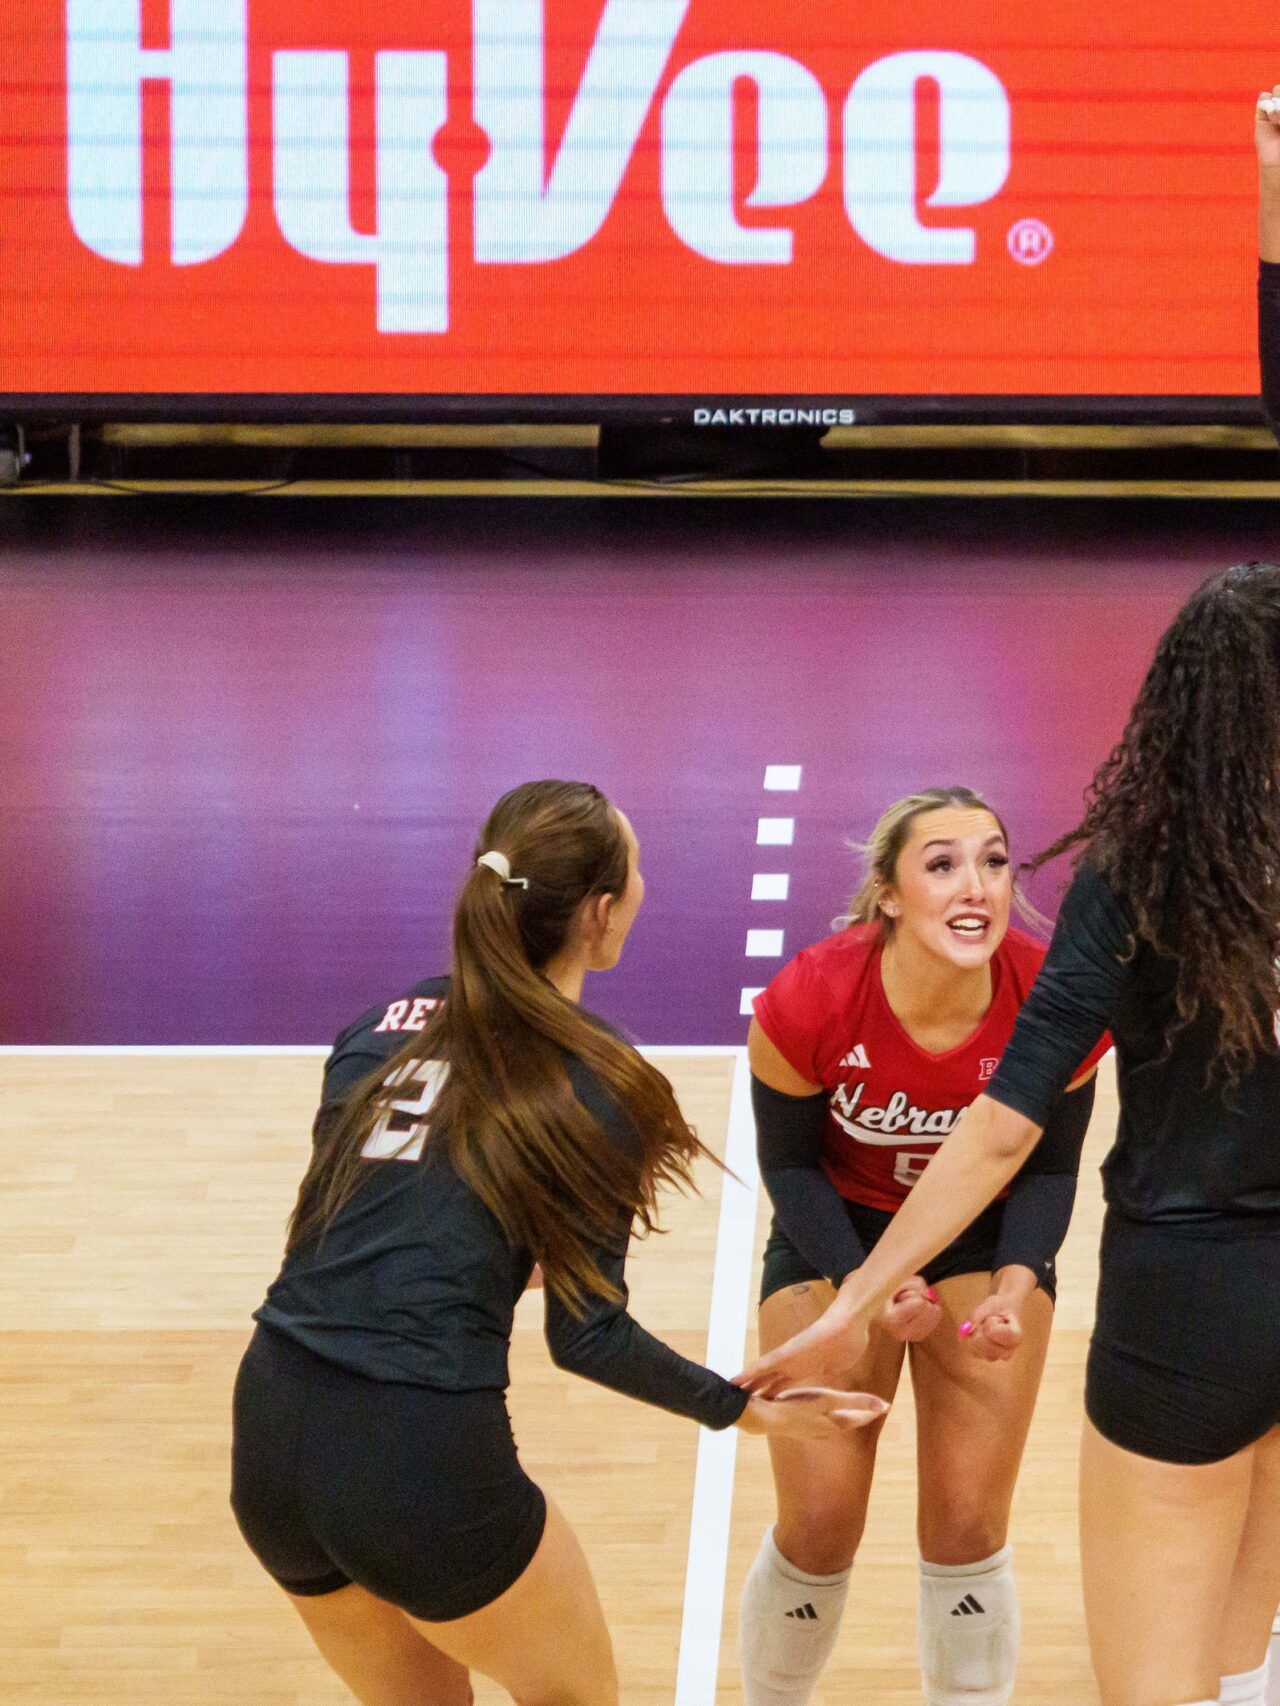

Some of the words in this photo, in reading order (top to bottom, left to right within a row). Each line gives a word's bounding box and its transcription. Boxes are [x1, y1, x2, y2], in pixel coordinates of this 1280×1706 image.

[693, 408, 855, 426] DAKTRONICS
[374, 998, 446, 1032] RE
[360, 1058, 450, 1161] 2
[829, 1082, 970, 1134] Nebra
